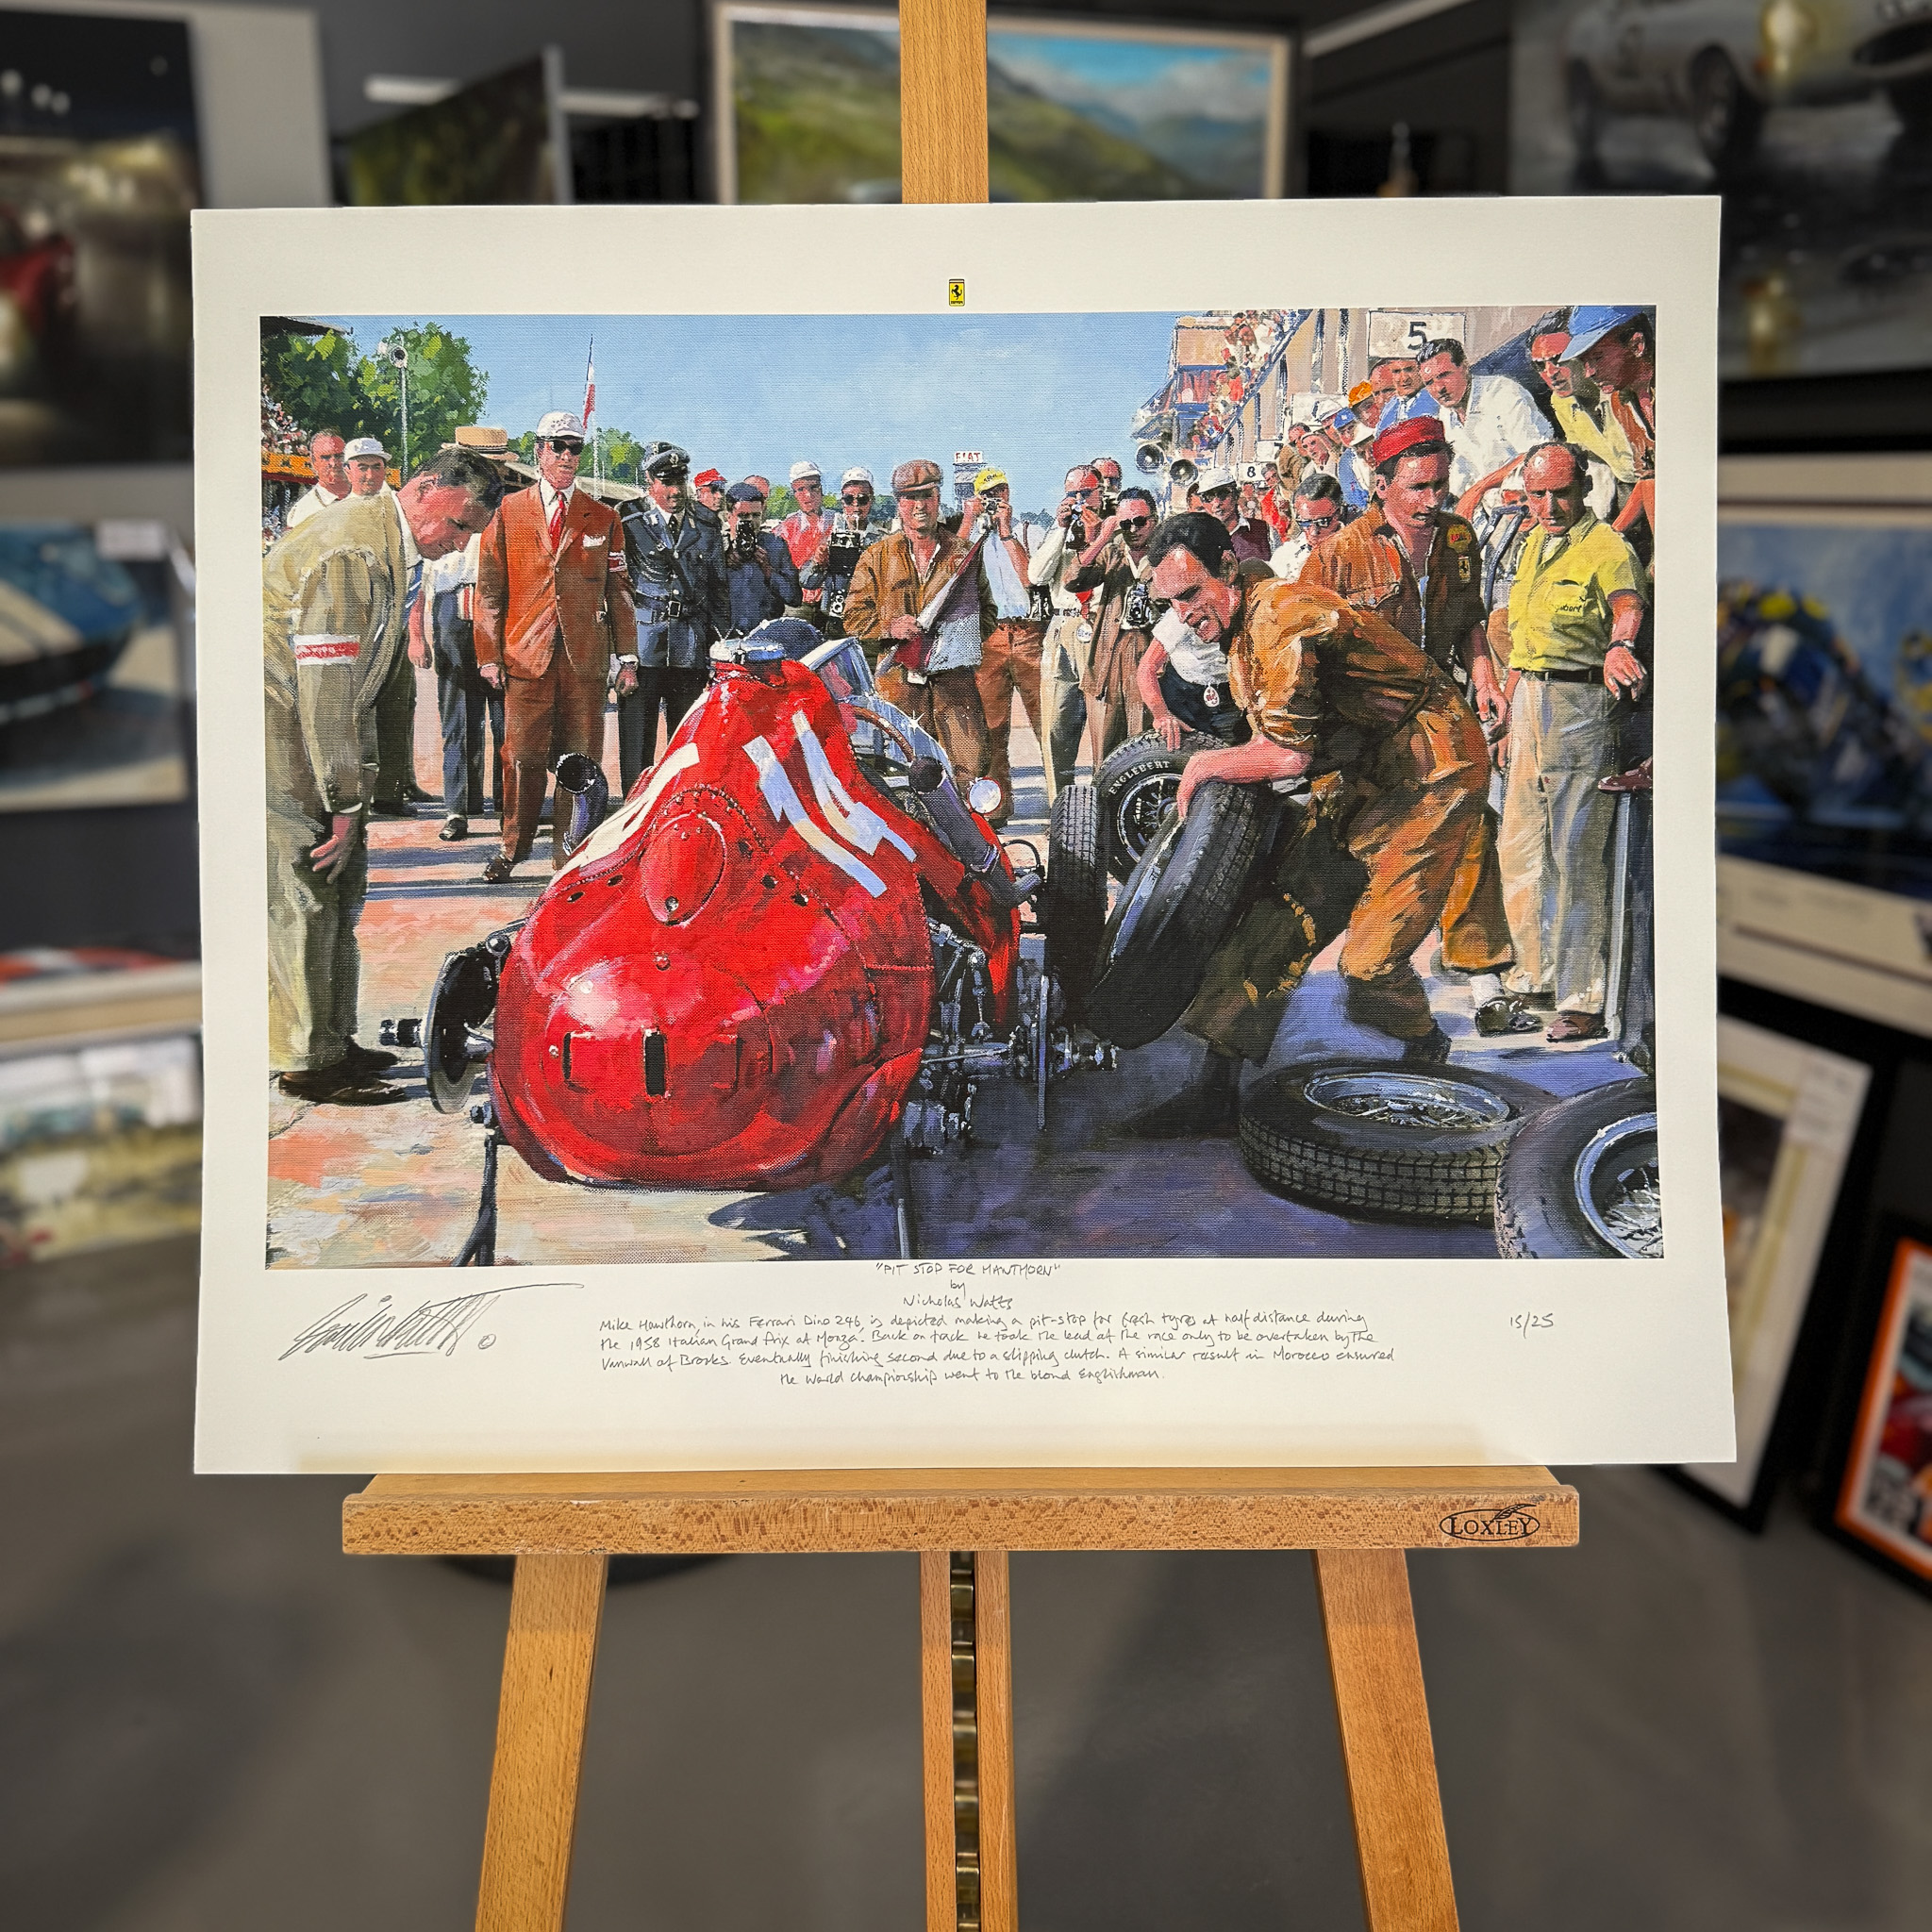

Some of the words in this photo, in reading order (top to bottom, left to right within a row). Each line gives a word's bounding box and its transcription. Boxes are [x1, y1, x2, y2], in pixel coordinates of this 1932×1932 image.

[1407, 321, 1427, 350] 5
[955, 452, 981, 462] FIAT
[1246, 465, 1257, 478] 8
[1108, 760, 1171, 794] ENGLEBERT
[914, 1262, 942, 1274] STOP
[949, 1263, 975, 1274] FOR
[950, 1279, 966, 1300] by
[903, 1294, 961, 1308] Nicholas
[971, 1294, 1013, 1310] Watts
[599, 1317, 633, 1331] Mike
[703, 1316, 715, 1327] in
[722, 1318, 741, 1329] his
[749, 1315, 795, 1328] Ferrari
[804, 1315, 830, 1325] Dino
[871, 1315, 883, 1328] is
[890, 1313, 947, 1330] depicted
[955, 1313, 1008, 1331] making
[1011, 1317, 1023, 1325] a
[1093, 1311, 1111, 1330] for
[1122, 1311, 1155, 1327] fresh
[1161, 1312, 1196, 1330] tyres
[1202, 1314, 1218, 1326] at
[1316, 1309, 1368, 1333] during
[1509, 1311, 1555, 1340] 15/25
[600, 1338, 621, 1351] the
[630, 1336, 659, 1351] 1958
[668, 1337, 717, 1347] Italian
[721, 1334, 758, 1350] Grand
[762, 1331, 790, 1348] Prix
[795, 1332, 811, 1345] at
[872, 1329, 908, 1341] Back
[929, 1329, 969, 1343] track
[977, 1331, 991, 1341] he
[994, 1329, 1033, 1341] took
[1038, 1331, 1058, 1341] the
[1063, 1329, 1092, 1341] lead
[1147, 1332, 1176, 1341] race
[1181, 1330, 1214, 1347] only
[1217, 1330, 1231, 1341] to
[1236, 1330, 1252, 1341] be
[1256, 1328, 1328, 1342] overtaken
[739, 1351, 811, 1367] Eventually
[819, 1350, 884, 1367] finishing
[886, 1352, 938, 1363] second
[942, 1349, 969, 1361] due
[973, 1348, 986, 1359] to
[1002, 1346, 1059, 1367] slipping
[1064, 1348, 1109, 1359] clutch.
[1118, 1347, 1131, 1359] A
[1135, 1345, 1187, 1359] similar
[1192, 1347, 1240, 1361] result
[1245, 1349, 1265, 1359] in
[1273, 1345, 1330, 1360] Morocco
[1336, 1347, 1394, 1361] ensured
[780, 1374, 798, 1385] the
[944, 1367, 980, 1381] went
[985, 1368, 999, 1380] to
[1005, 1369, 1025, 1379] the
[1030, 1370, 1071, 1380] blond
[1449, 1517, 1534, 1536] LOXLEY
